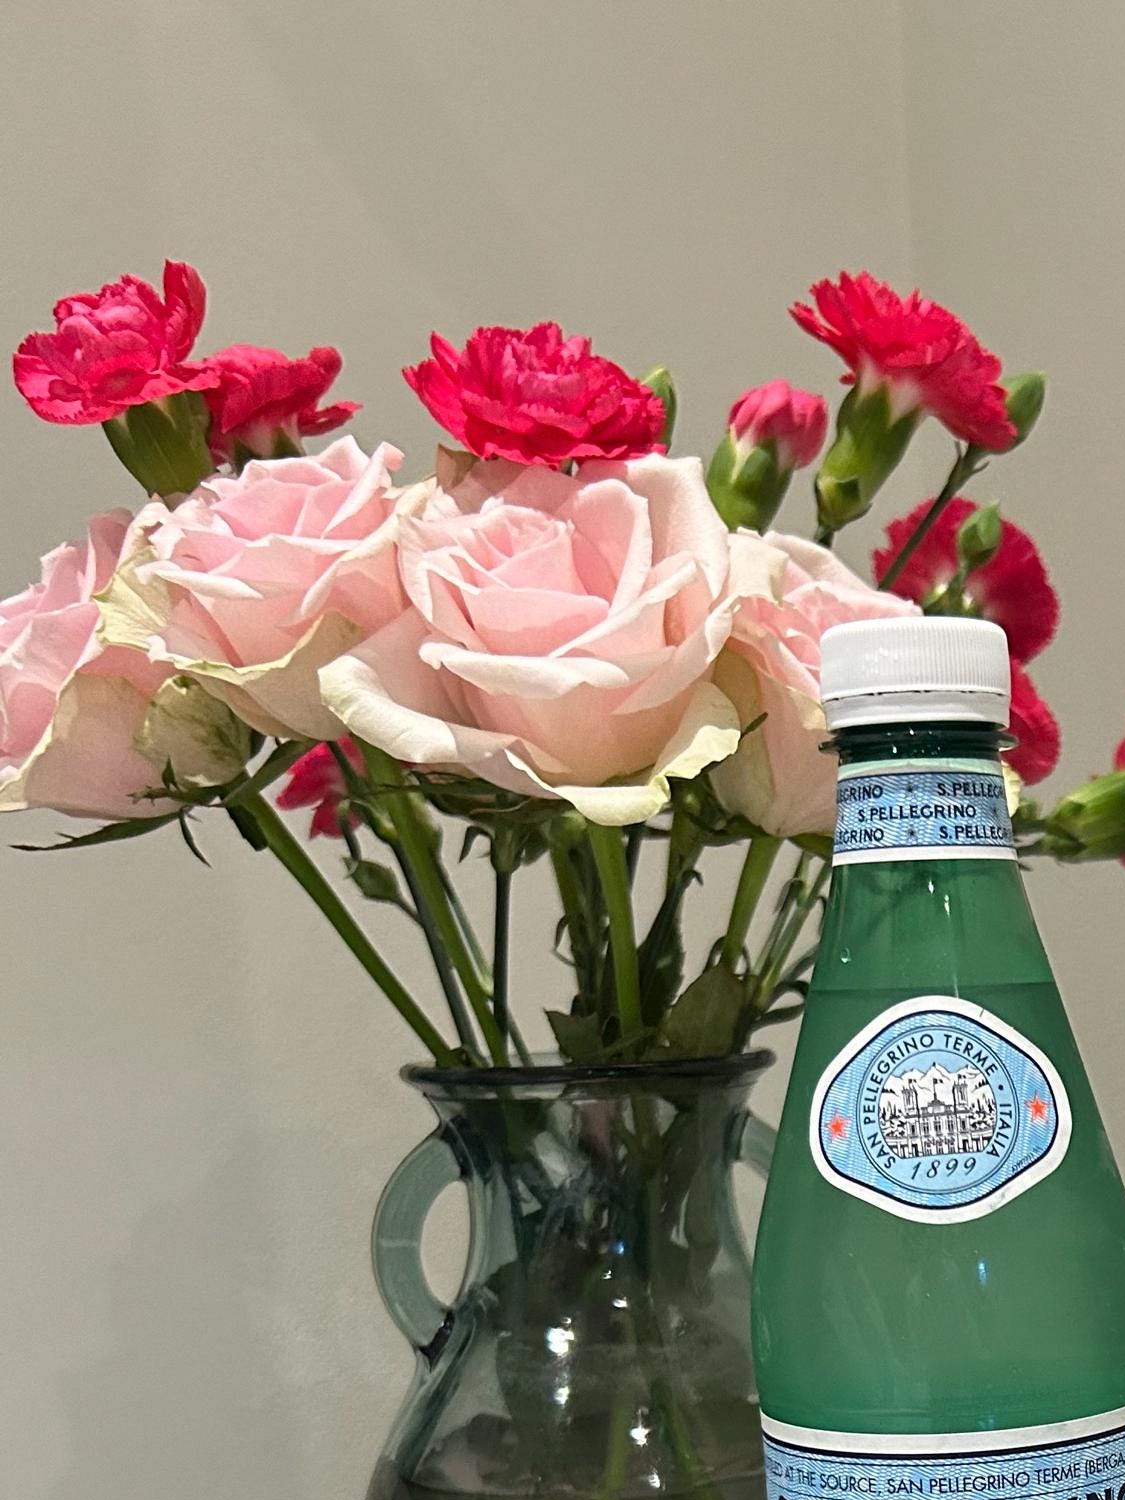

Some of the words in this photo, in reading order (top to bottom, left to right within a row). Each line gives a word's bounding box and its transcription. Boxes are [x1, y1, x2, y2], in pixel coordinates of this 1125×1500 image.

[858, 804, 976, 823] S.PELLEGRINO
[943, 1033, 998, 1077] TERME
[863, 1033, 934, 1125] PELLEGRINO
[987, 1103, 1013, 1158] ITALIA
[868, 1134, 896, 1169] SAN
[910, 1157, 977, 1180] 1899
[796, 1468, 817, 1487] THE
[819, 1473, 882, 1495] SOURCE,
[887, 1478, 924, 1494] SAN
[929, 1471, 1030, 1494] PELLEGRINO
[1035, 1463, 1081, 1485] TERME
